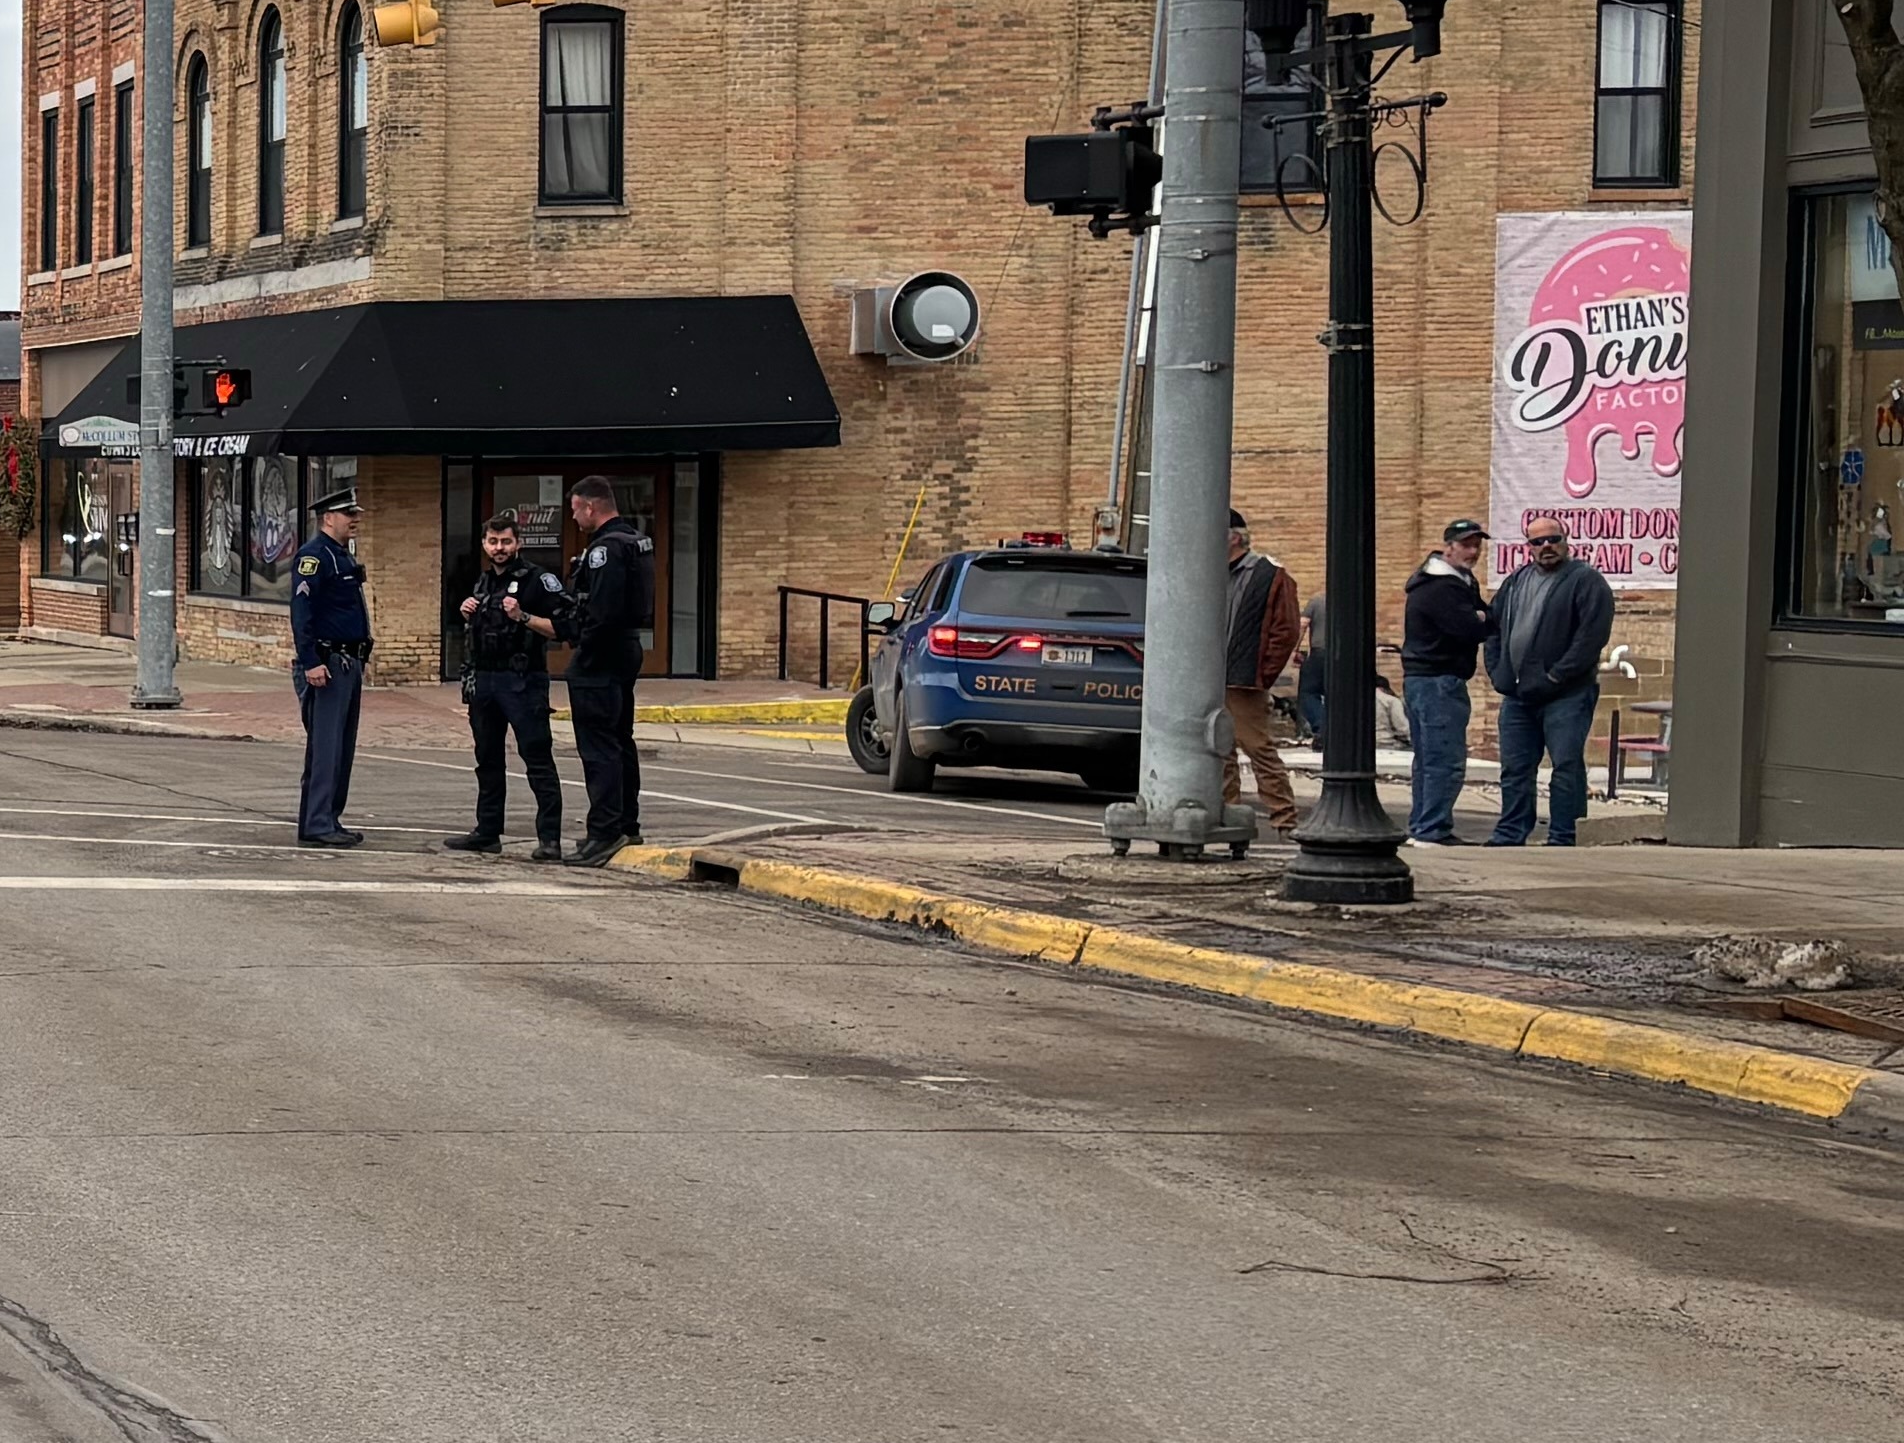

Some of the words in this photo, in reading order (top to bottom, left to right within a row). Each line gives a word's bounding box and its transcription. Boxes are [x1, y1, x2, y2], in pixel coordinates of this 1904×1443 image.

[1585, 296, 1685, 335] ETHAN'S
[1511, 328, 1688, 422] Donu
[1595, 385, 1679, 411] FACTO
[218, 435, 250, 455] CREAM
[1521, 508, 1624, 539] CSTOM
[974, 675, 1037, 694] STATE
[1082, 681, 1144, 700] POLIC
